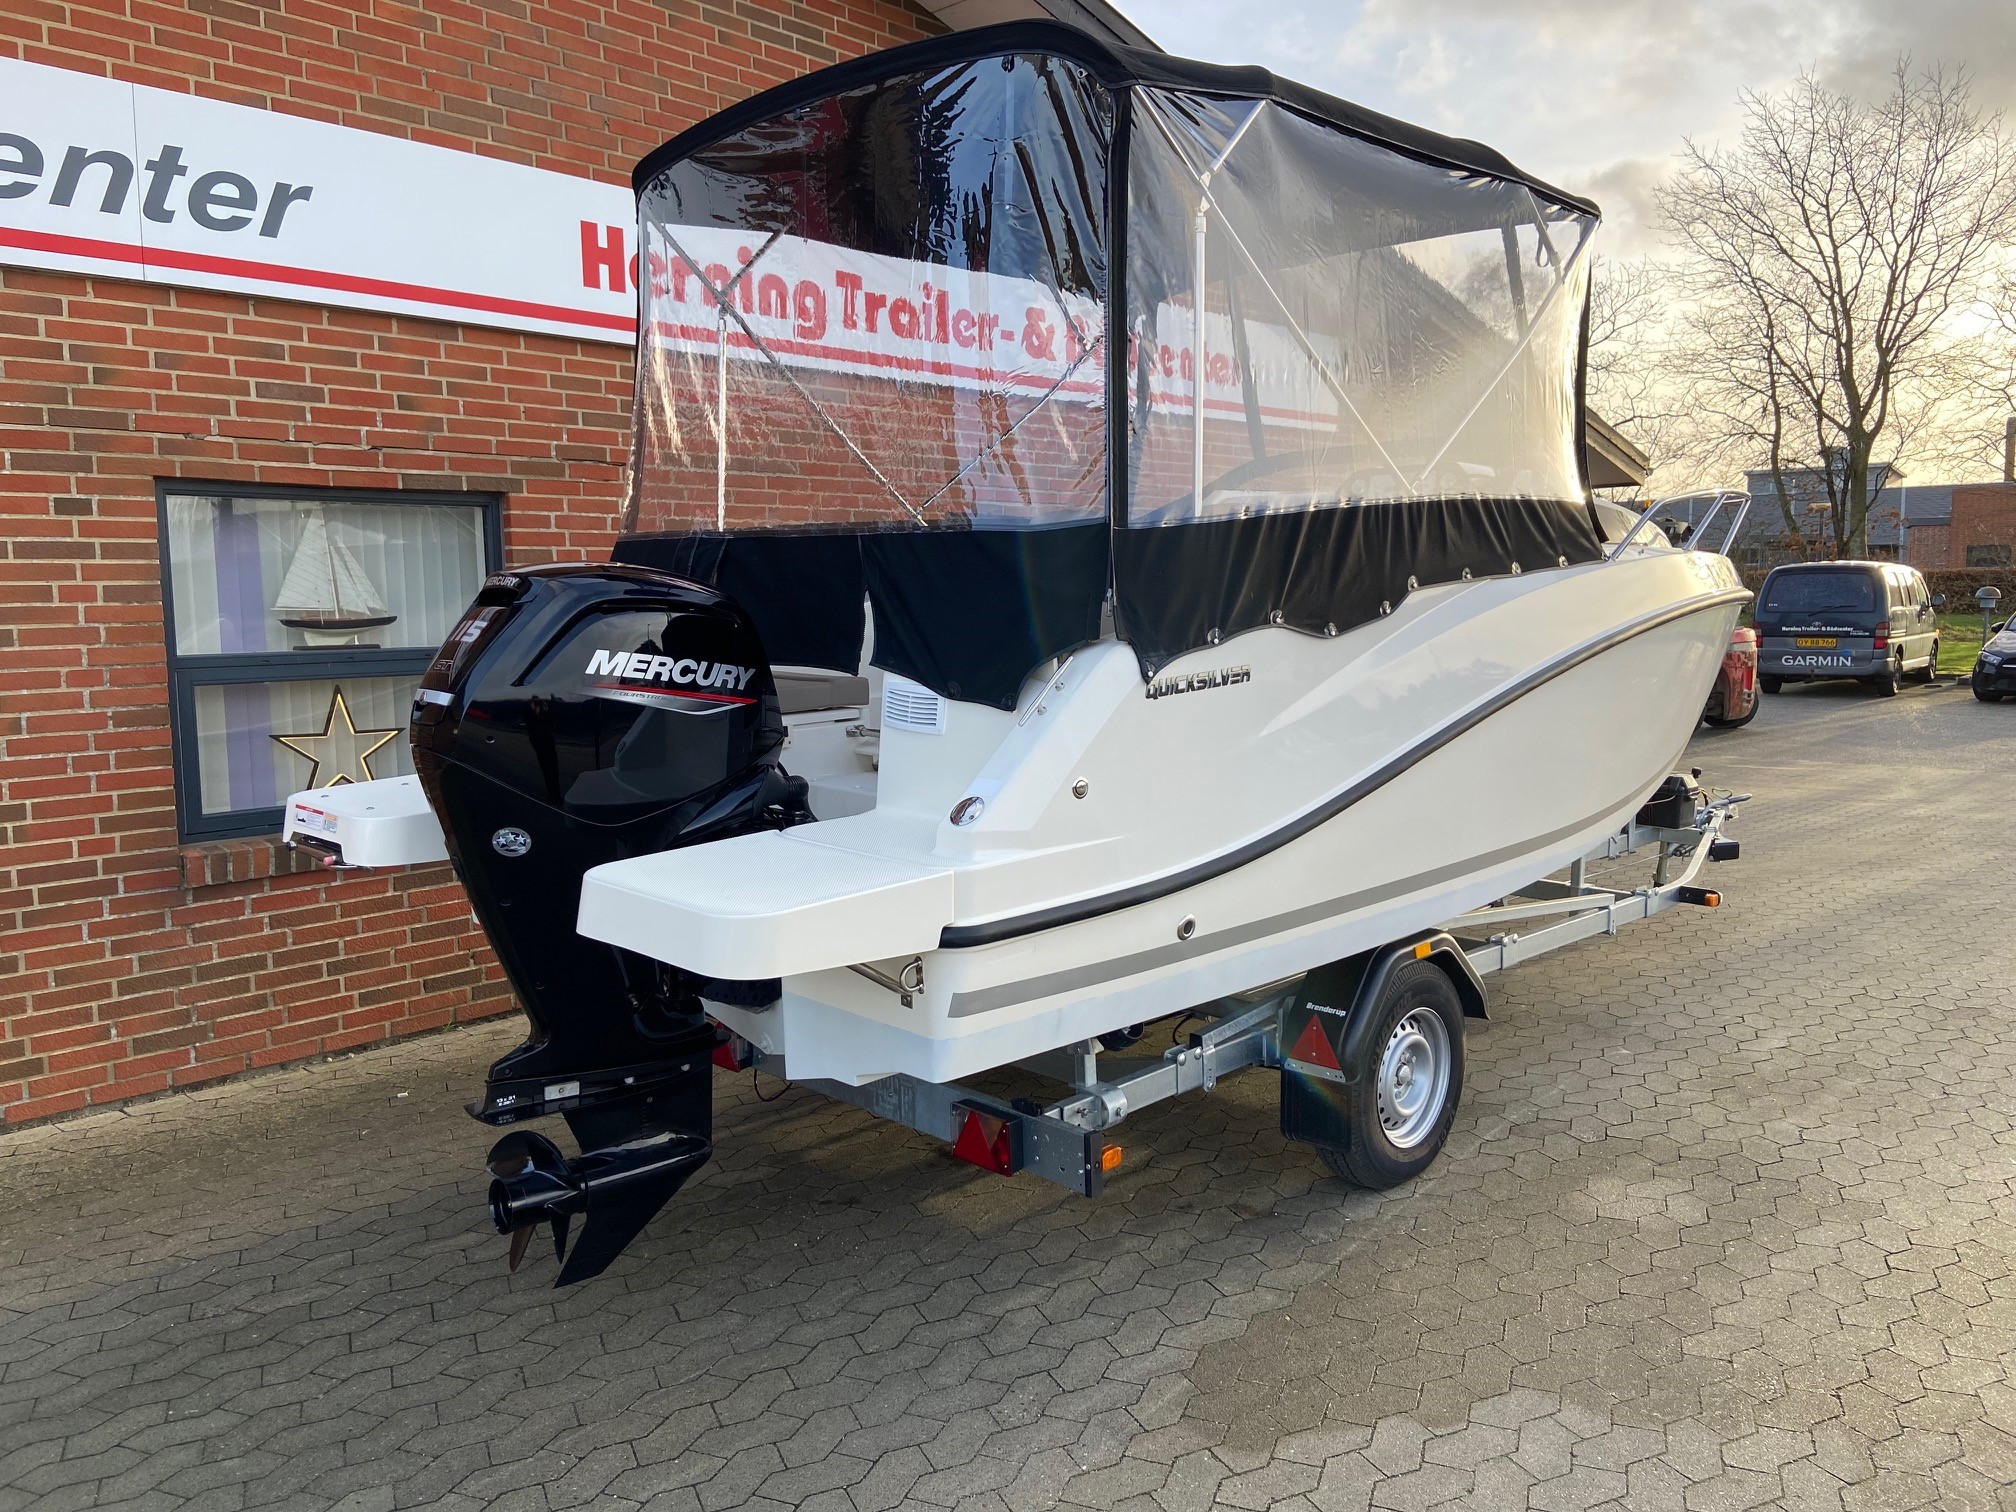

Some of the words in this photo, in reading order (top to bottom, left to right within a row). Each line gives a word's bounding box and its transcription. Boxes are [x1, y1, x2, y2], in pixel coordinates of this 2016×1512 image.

[580, 219, 828, 342] Herning
[835, 269, 1015, 352] Trailer-
[1023, 306, 1057, 363] &
[1065, 314, 1242, 388] Benter
[486, 576, 520, 587] MERCURY
[450, 621, 489, 642] 115
[585, 649, 756, 691] MERCURY
[1781, 655, 1851, 667] GARMIN
[1145, 664, 1252, 700] QUICKSILVER
[1306, 1002, 1347, 1017] Brenderup
